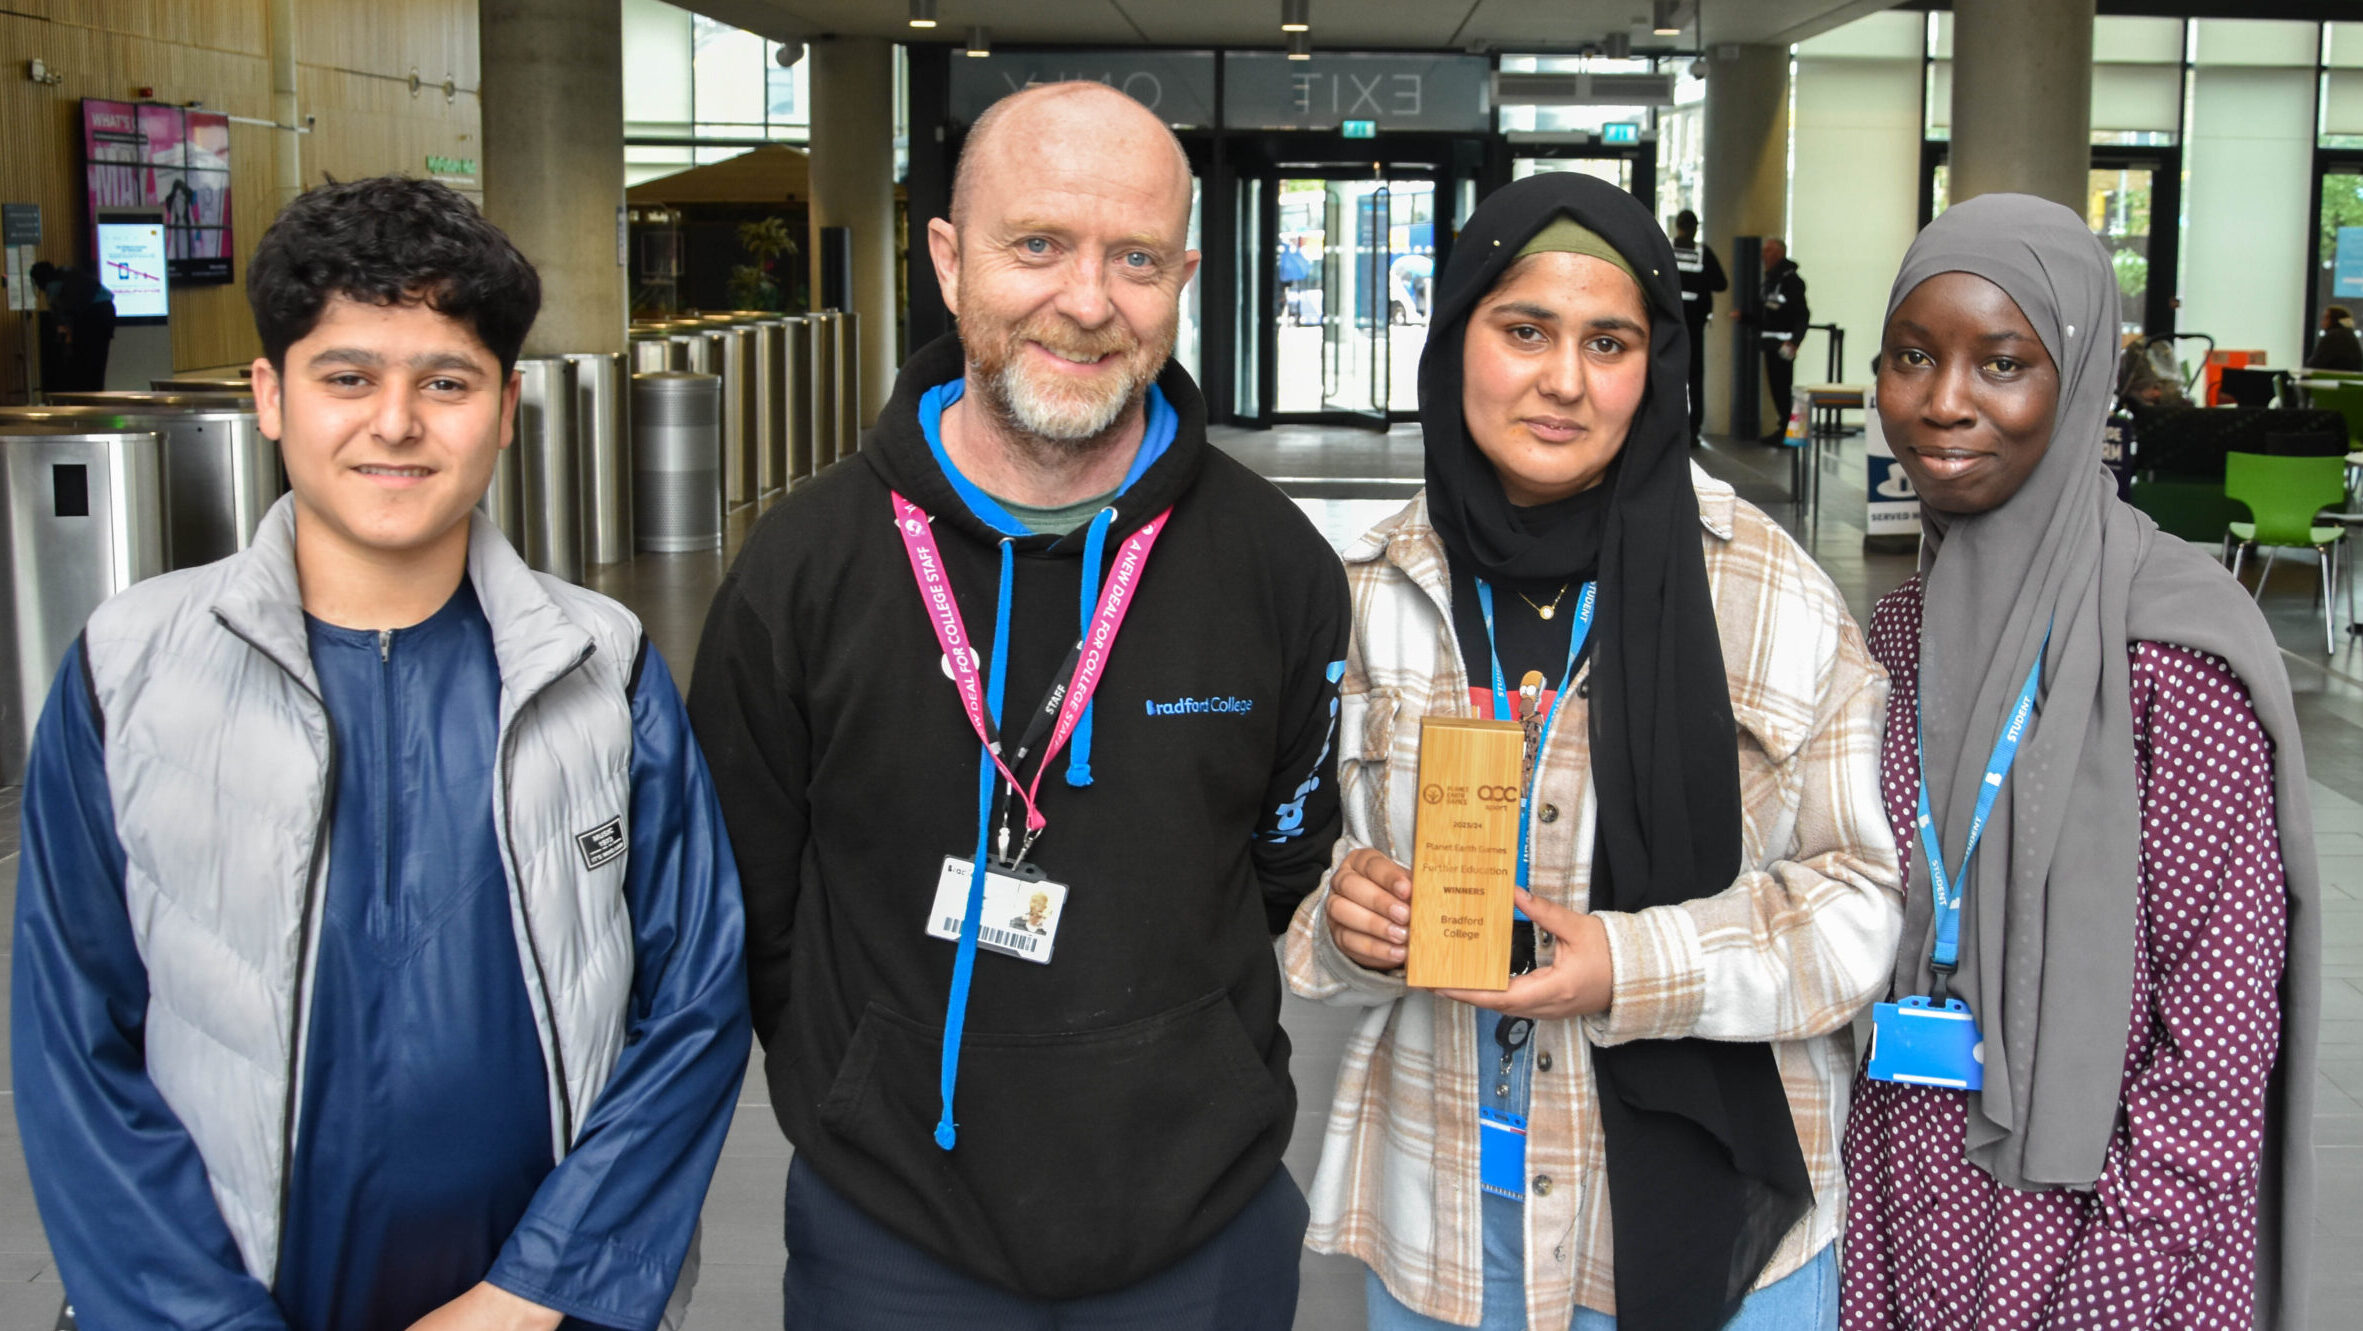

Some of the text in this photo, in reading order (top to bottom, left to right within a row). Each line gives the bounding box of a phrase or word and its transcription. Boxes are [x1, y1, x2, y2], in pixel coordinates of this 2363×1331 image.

[1129, 539, 1142, 551] A
[916, 546, 940, 583] STAFF
[1117, 552, 1138, 586] NEW
[929, 584, 960, 645] COLLEGE
[1103, 584, 1125, 619] DEAL
[1092, 620, 1110, 649] FOR
[952, 647, 972, 673] FOR
[964, 676, 979, 711] DEAL
[1069, 650, 1100, 712] COLLEGE
[1045, 684, 1066, 715] STAFF
[1211, 696, 1253, 715] College
[2007, 695, 2031, 743] STUDENT
[1426, 842, 1507, 854] Planet Earth Games
[1422, 863, 1508, 876] Further Education
[1931, 860, 1948, 907] STUDENT
[1443, 886, 1485, 896] WINNERS
[1441, 915, 1484, 926] Bradford
[1443, 928, 1480, 940] College
